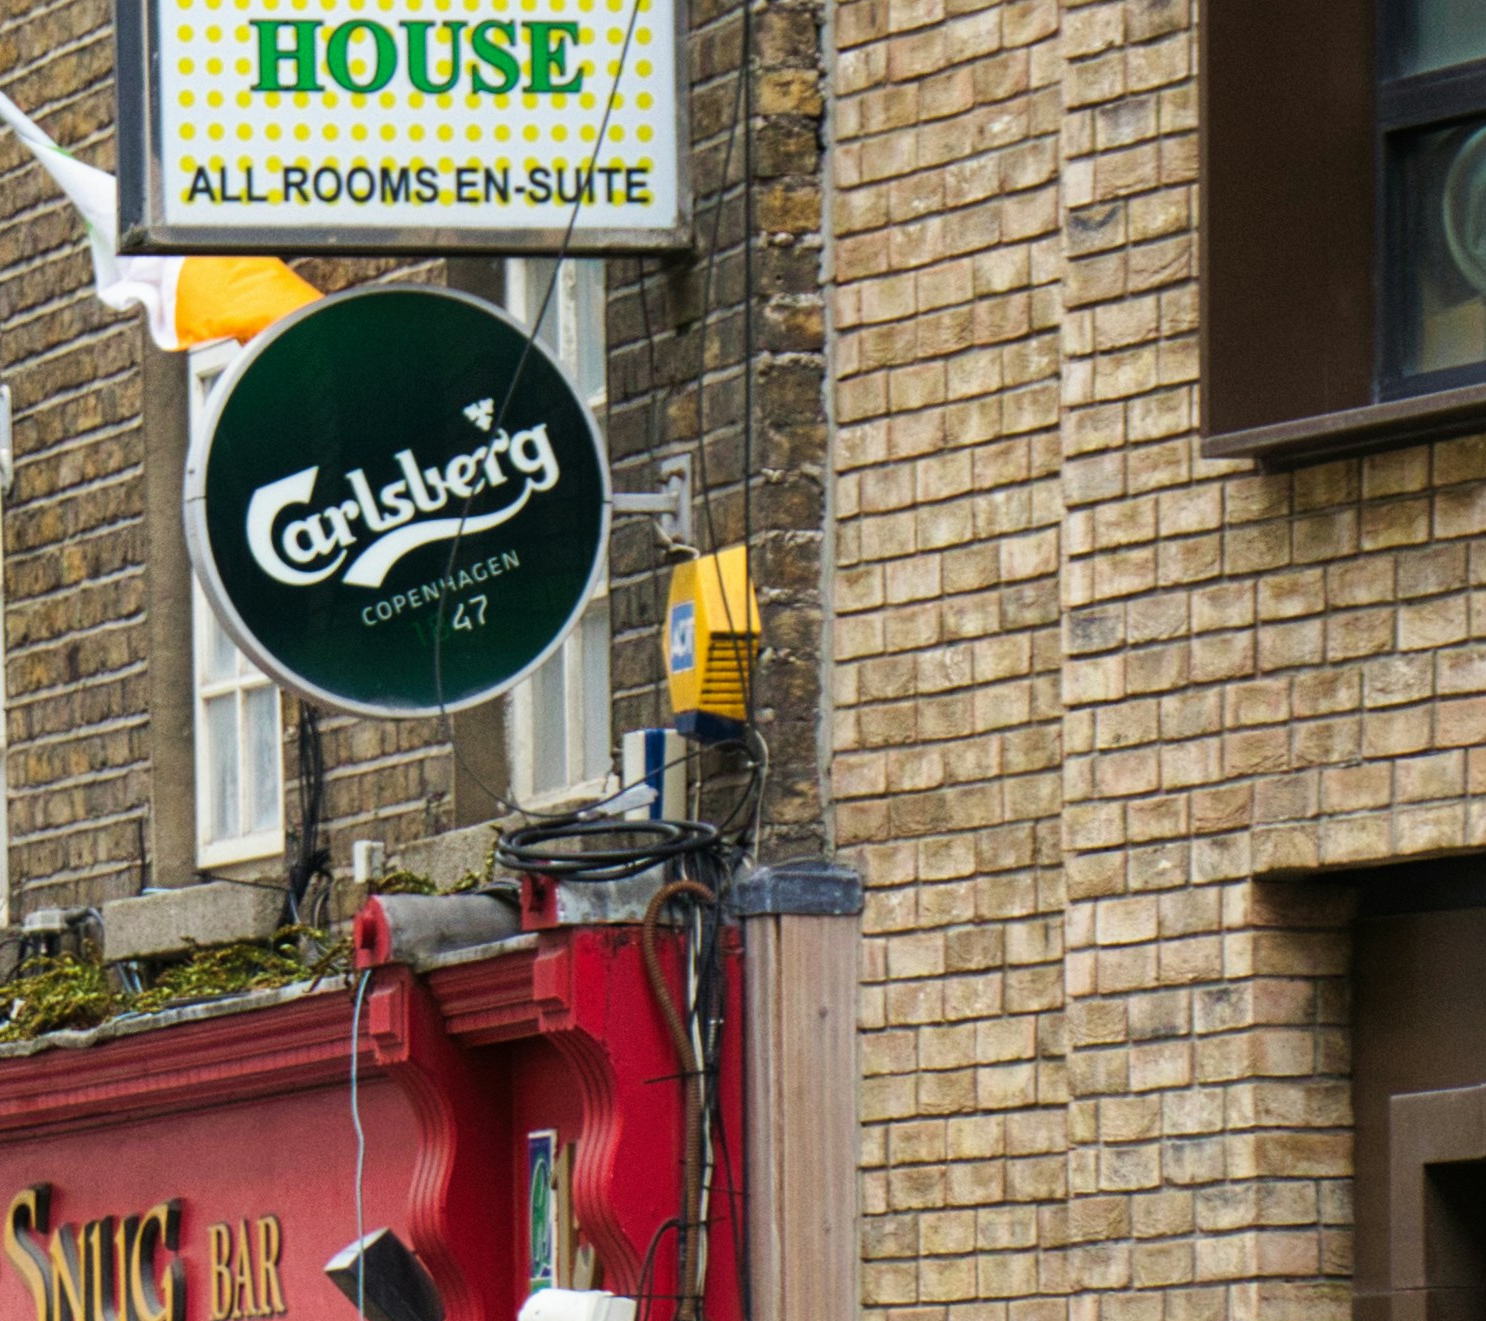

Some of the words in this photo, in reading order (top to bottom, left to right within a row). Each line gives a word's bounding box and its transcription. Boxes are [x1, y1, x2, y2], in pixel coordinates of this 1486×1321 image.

[249, 18, 586, 95] HOUSE
[187, 167, 269, 203] ALL
[282, 166, 440, 204] ROOMS
[455, 167, 651, 204] EN-SUITE
[245, 421, 562, 588] Carlsberg
[360, 549, 521, 627] COPENHAGEN
